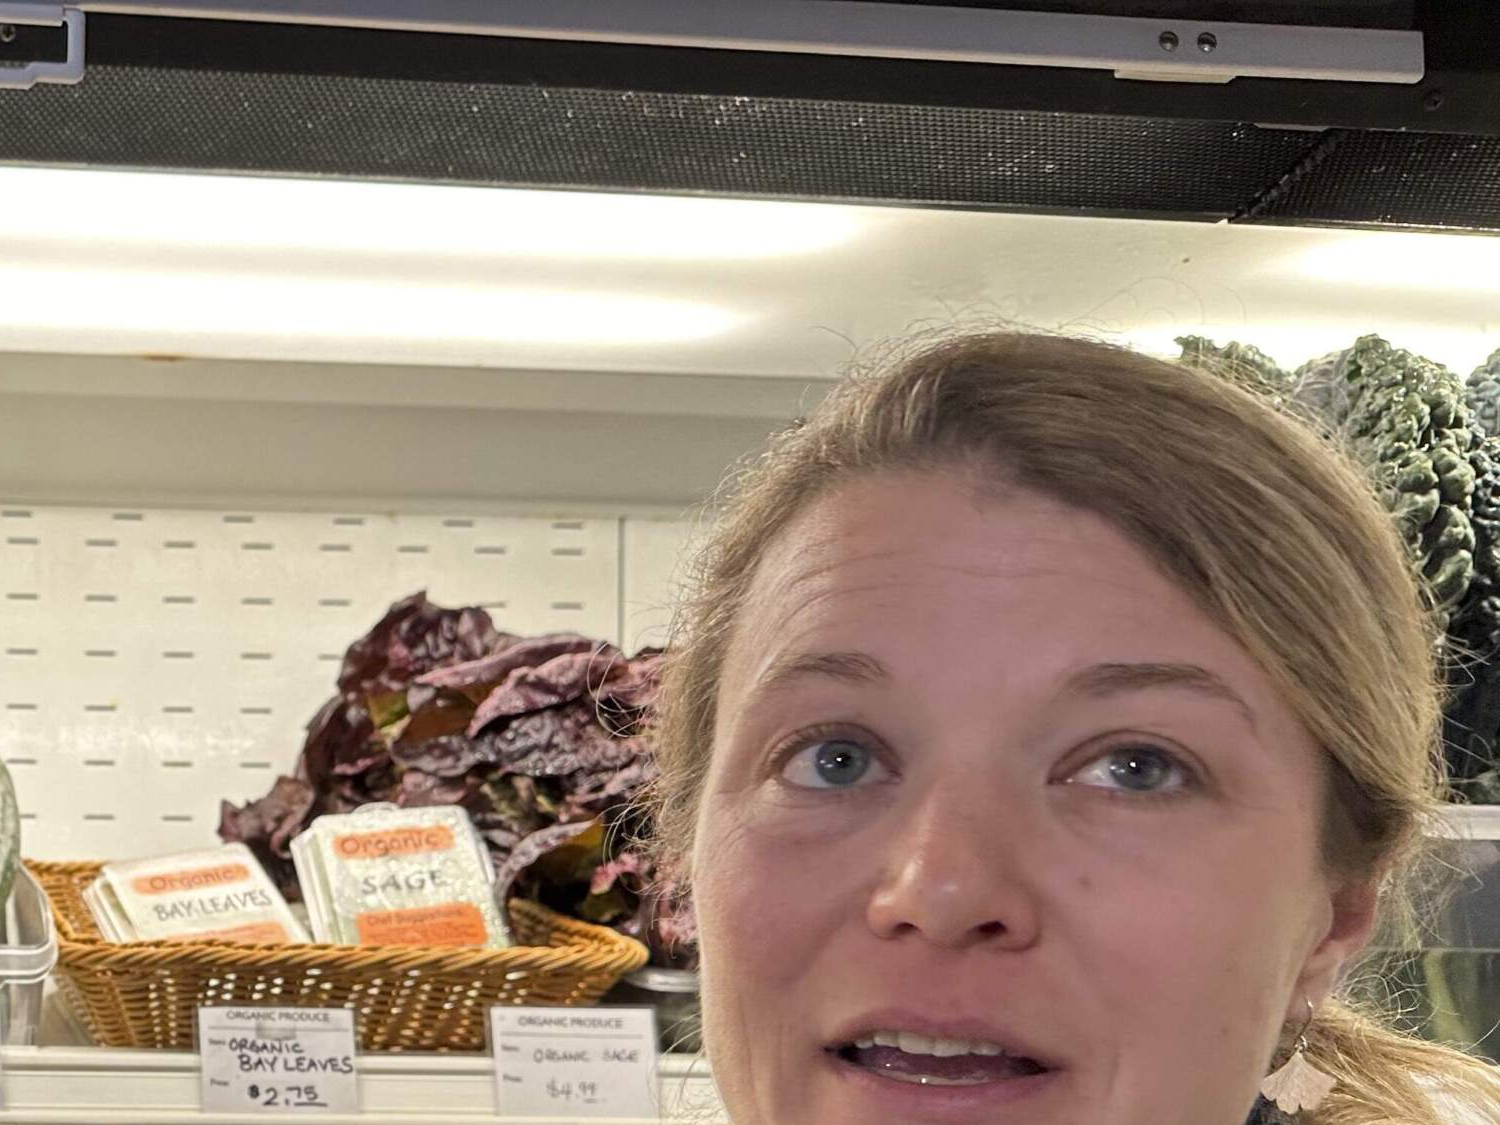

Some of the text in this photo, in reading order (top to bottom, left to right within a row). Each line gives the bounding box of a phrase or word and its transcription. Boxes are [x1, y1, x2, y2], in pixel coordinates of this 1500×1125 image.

[340, 833, 439, 857] Organic
[150, 868, 235, 890] Organic
[362, 869, 450, 895] SAGE
[153, 889, 273, 921] BAY LEAVES
[226, 1011, 331, 1022] ORGANIC PRODUCE
[517, 1016, 623, 1029] ORGANIC PRODUCE
[228, 1037, 304, 1053] ORGANIC
[237, 1054, 354, 1074] BAY LEAVES
[248, 1084, 322, 1106] $2.75
